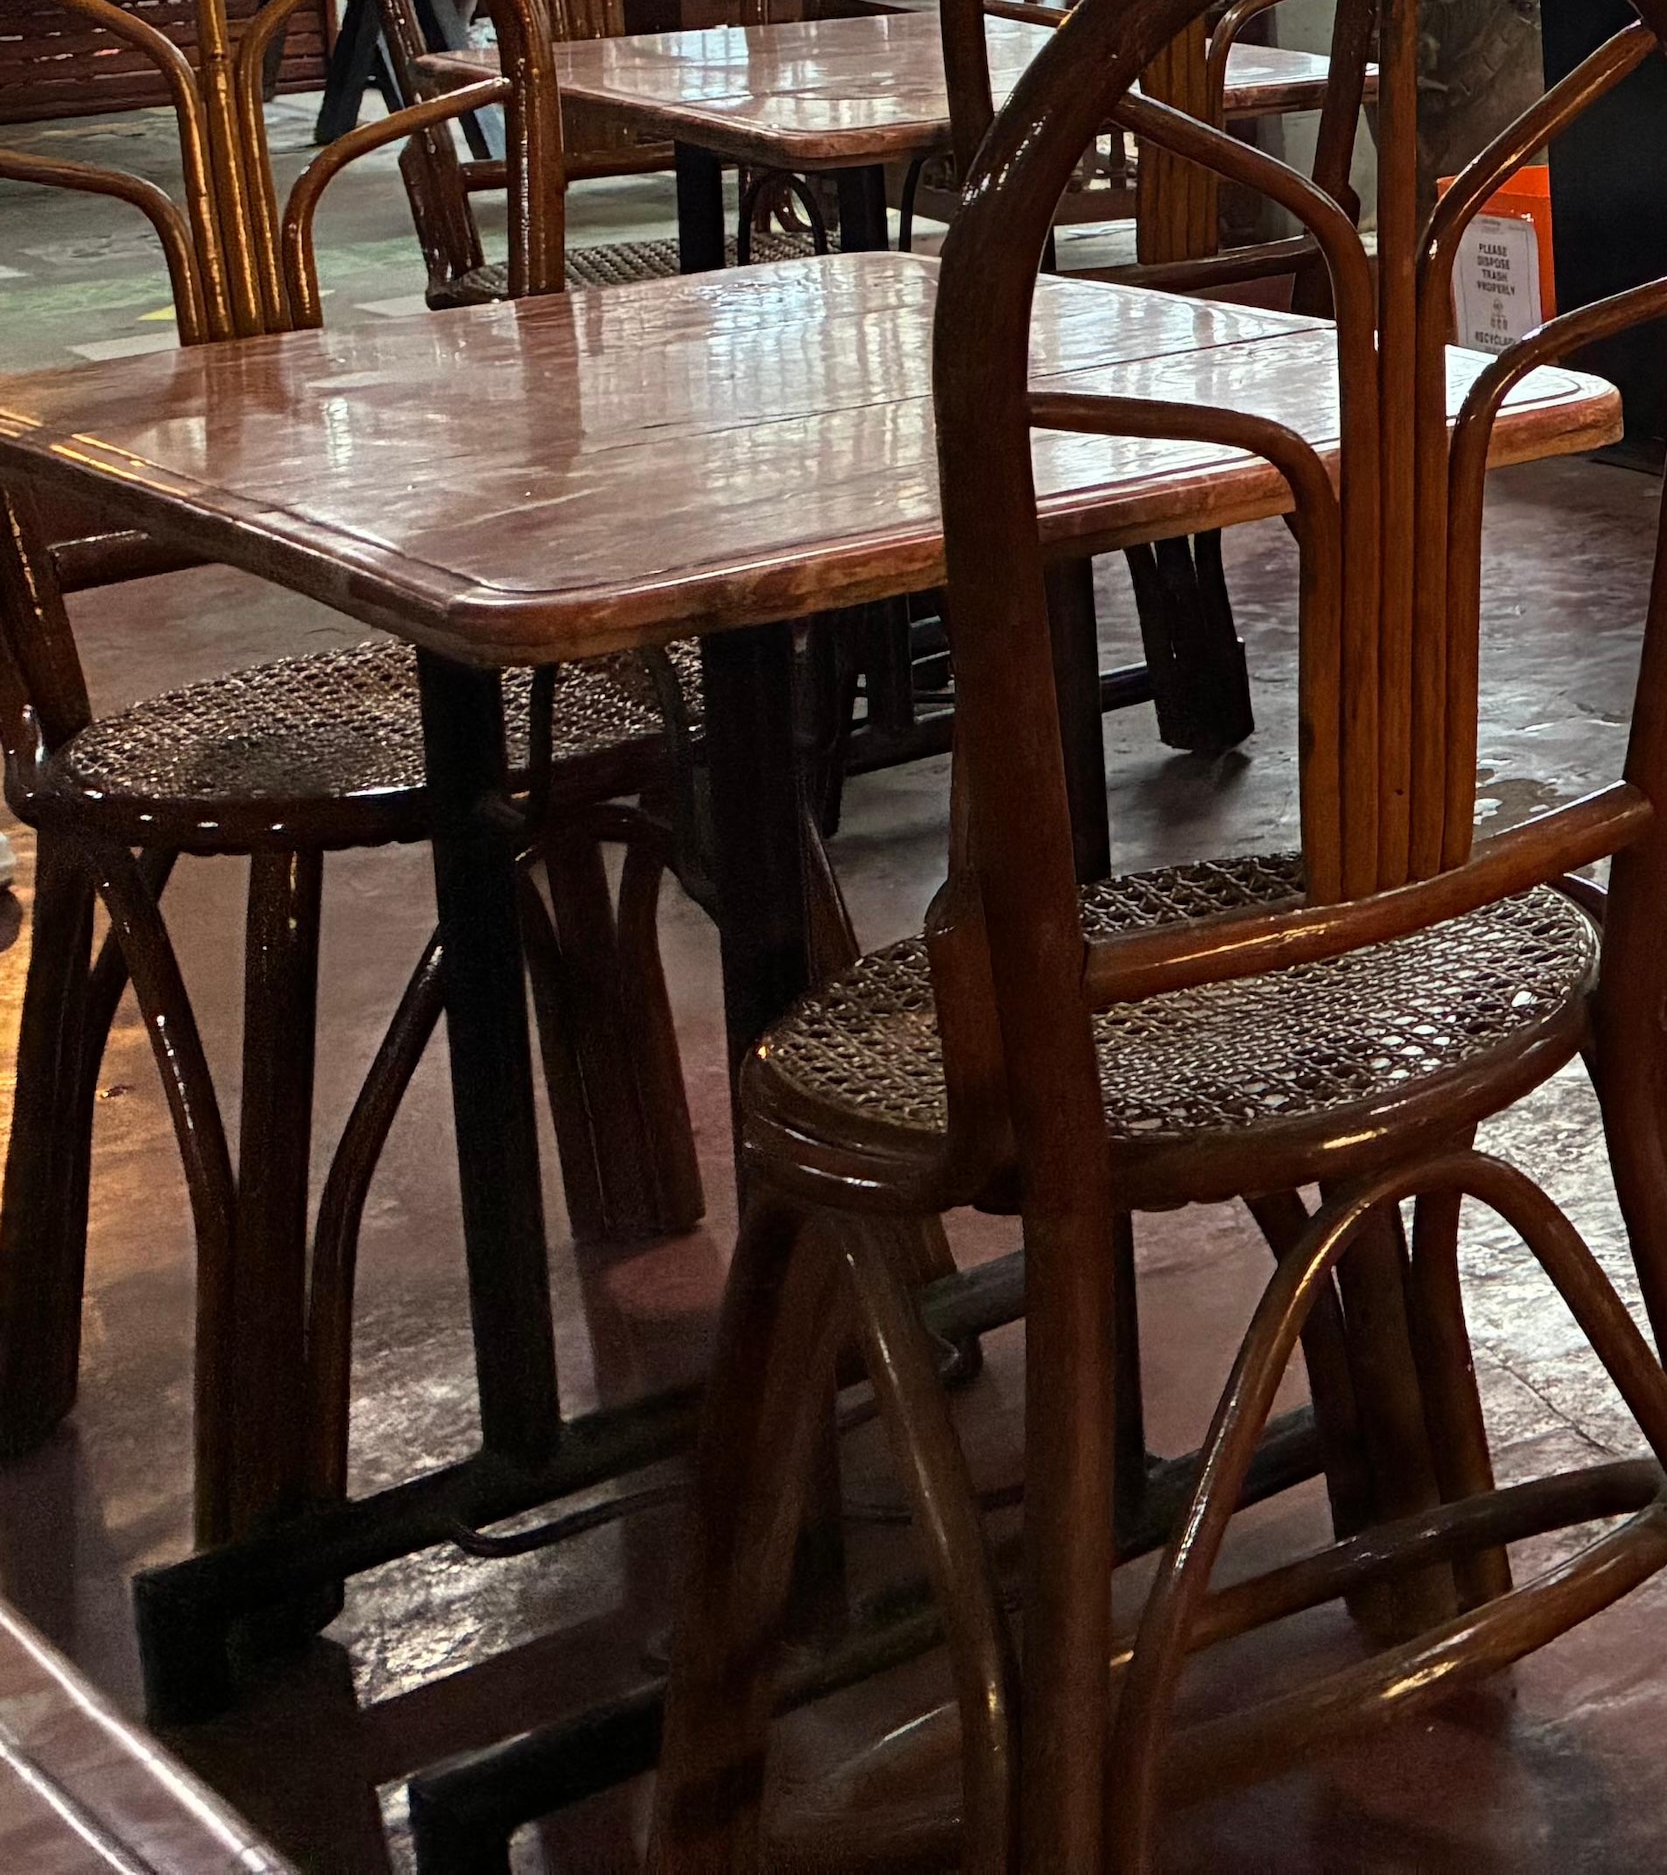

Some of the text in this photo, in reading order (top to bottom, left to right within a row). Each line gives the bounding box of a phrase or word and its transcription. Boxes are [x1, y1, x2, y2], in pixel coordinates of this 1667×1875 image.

[1478, 242, 1508, 257] PLEASE
[1477, 255, 1510, 270] DISPOSE
[1481, 269, 1508, 282] TRASH
